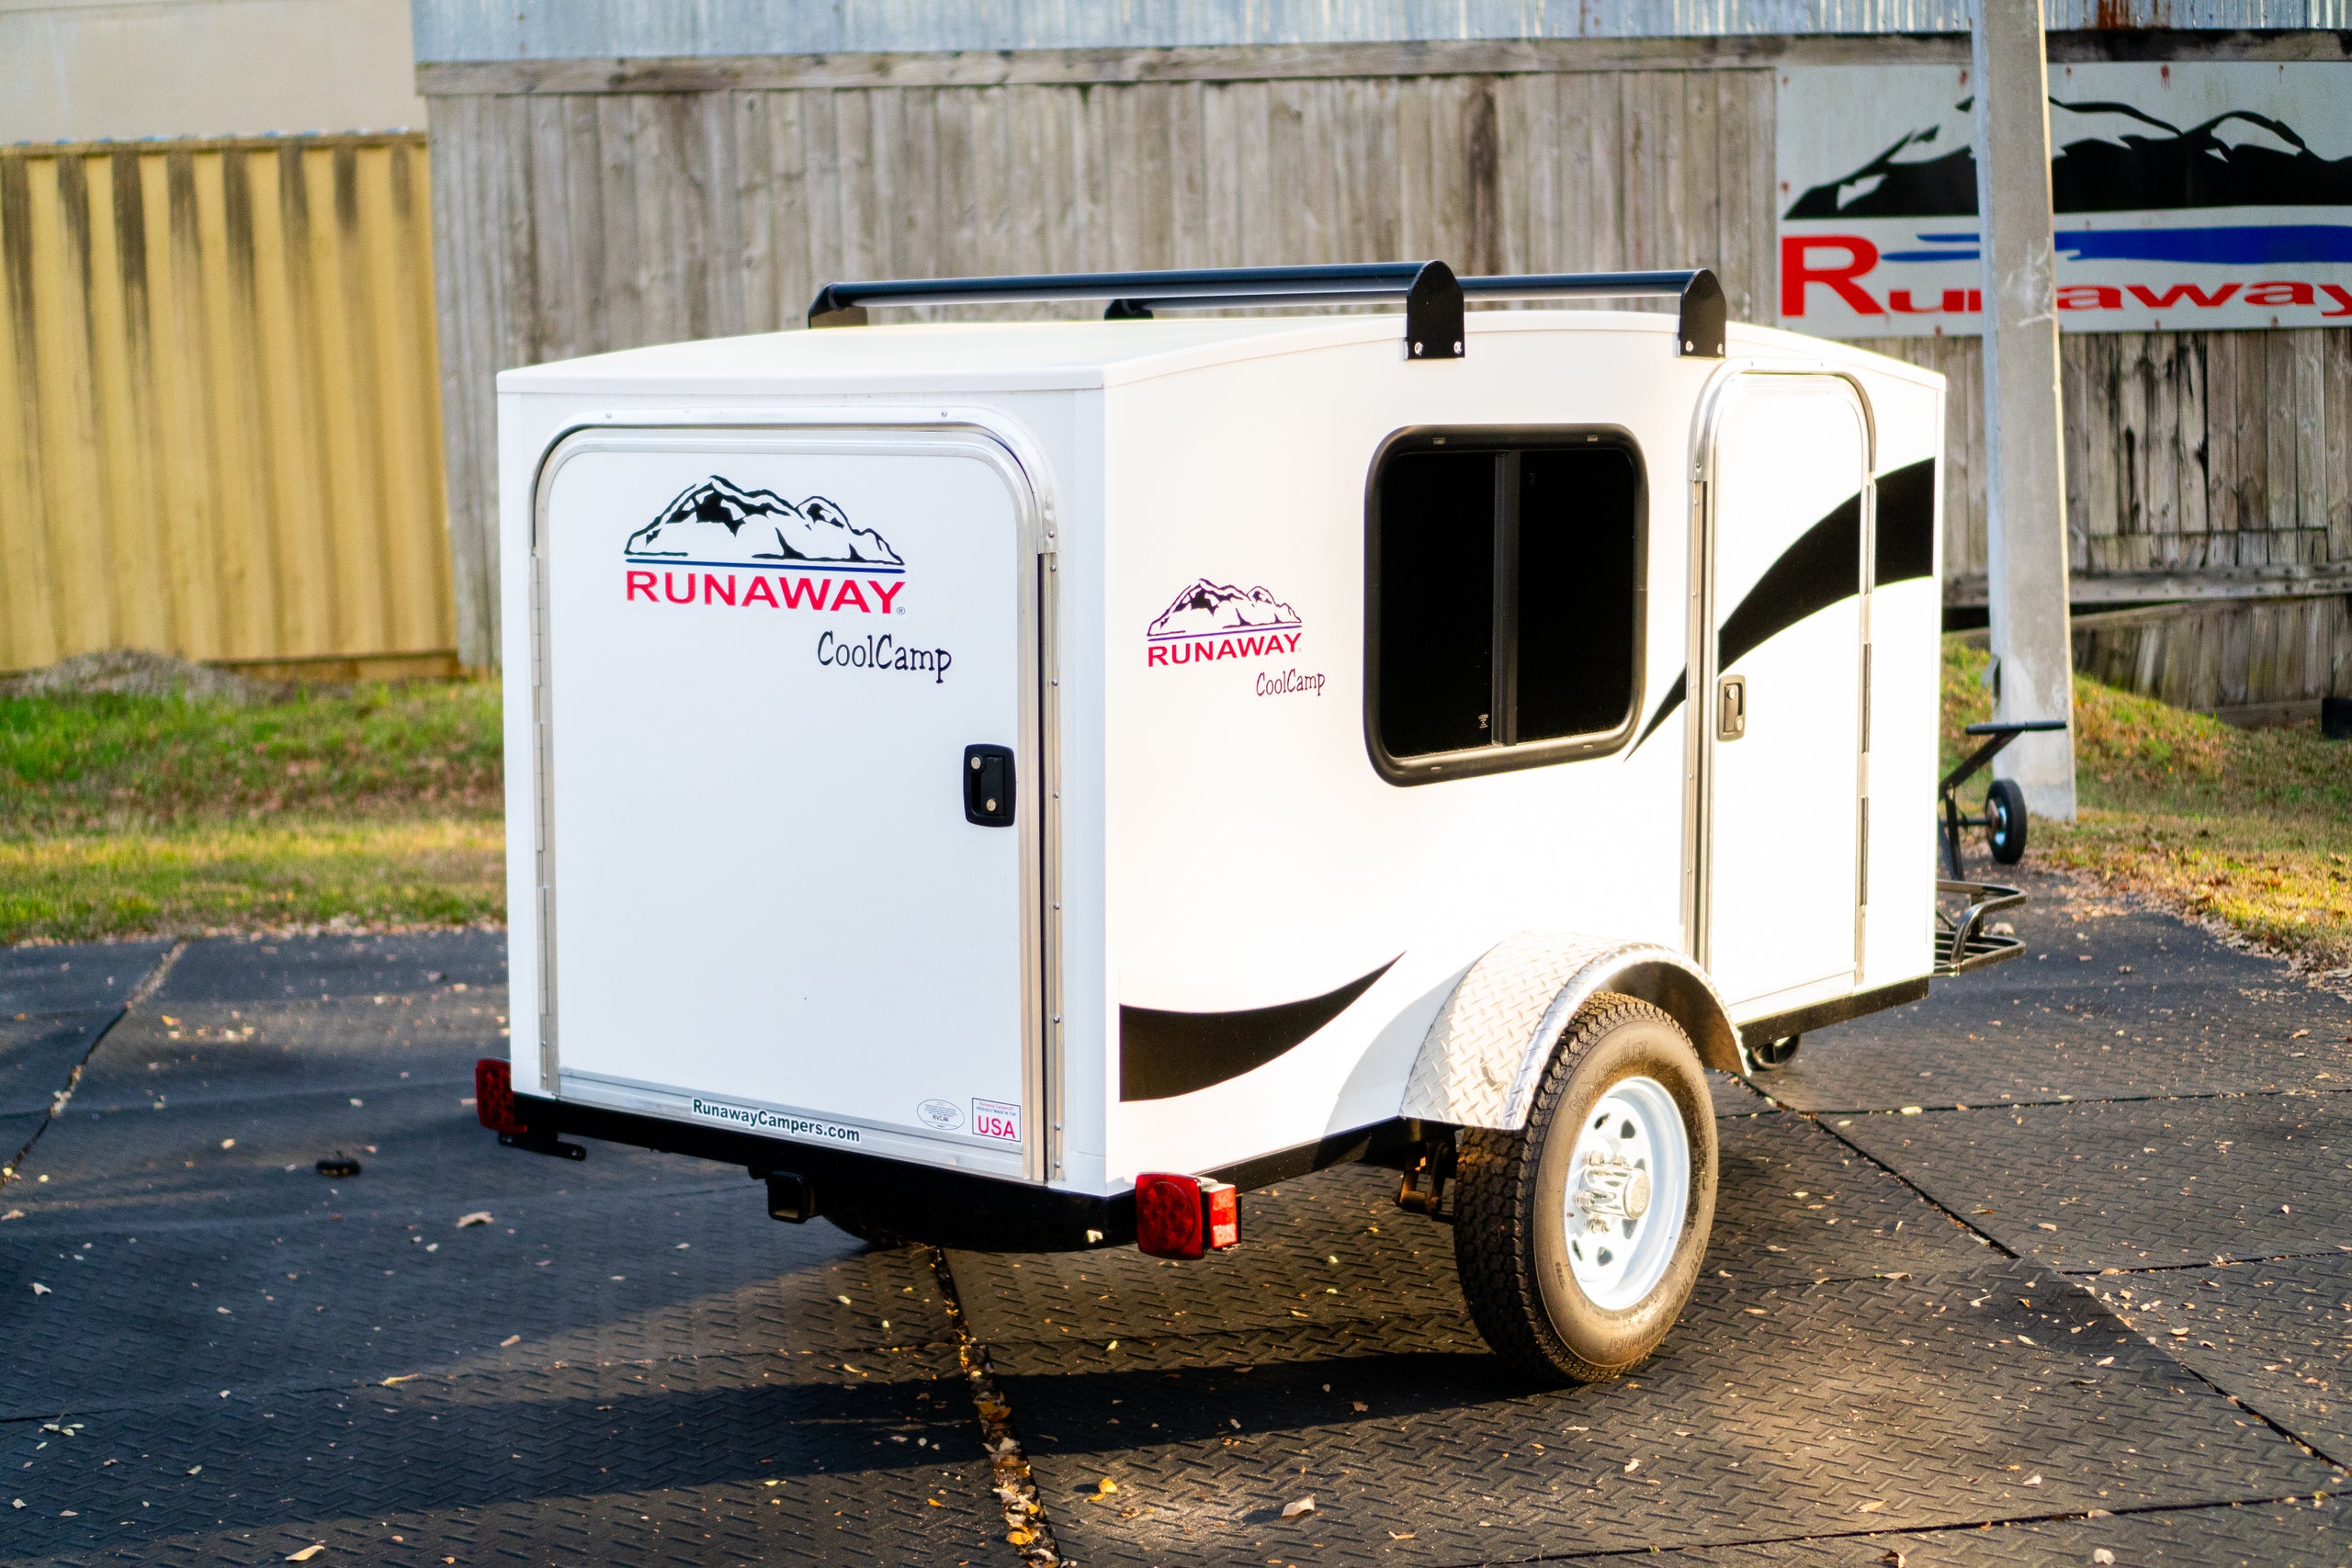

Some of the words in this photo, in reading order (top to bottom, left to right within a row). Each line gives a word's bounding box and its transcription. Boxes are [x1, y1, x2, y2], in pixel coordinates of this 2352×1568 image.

[1781, 234, 2352, 319] Ruaway
[817, 630, 953, 684] CoolCamp
[1148, 632, 1302, 668] RUNAWAY
[1256, 668, 1326, 696] CoolCamp
[693, 1099, 860, 1142] RunawayCampers.com
[978, 1115, 1016, 1139] USA
